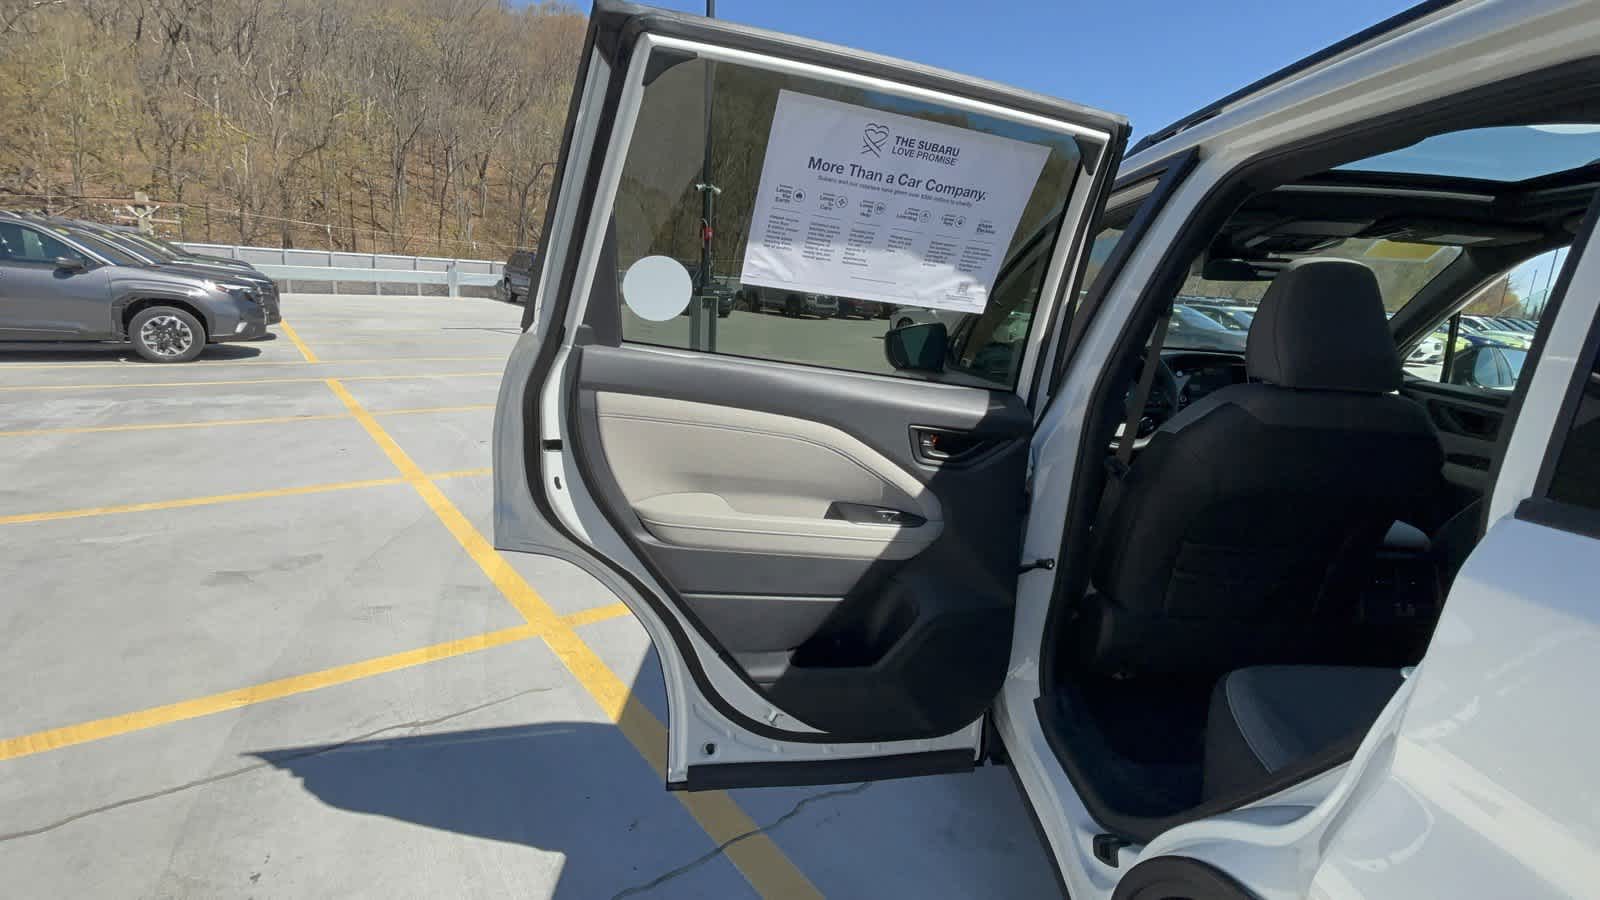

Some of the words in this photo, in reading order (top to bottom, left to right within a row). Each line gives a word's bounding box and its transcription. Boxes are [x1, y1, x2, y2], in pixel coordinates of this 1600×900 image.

[891, 147, 915, 159] LOVE
[916, 152, 957, 166] PROMISE
[895, 136, 917, 148] THE
[917, 140, 960, 157] SUBARU
[808, 157, 845, 174] More
[849, 164, 883, 181] Than
[886, 174, 895, 184] a
[898, 174, 922, 189] Car
[925, 179, 987, 202] Company.
